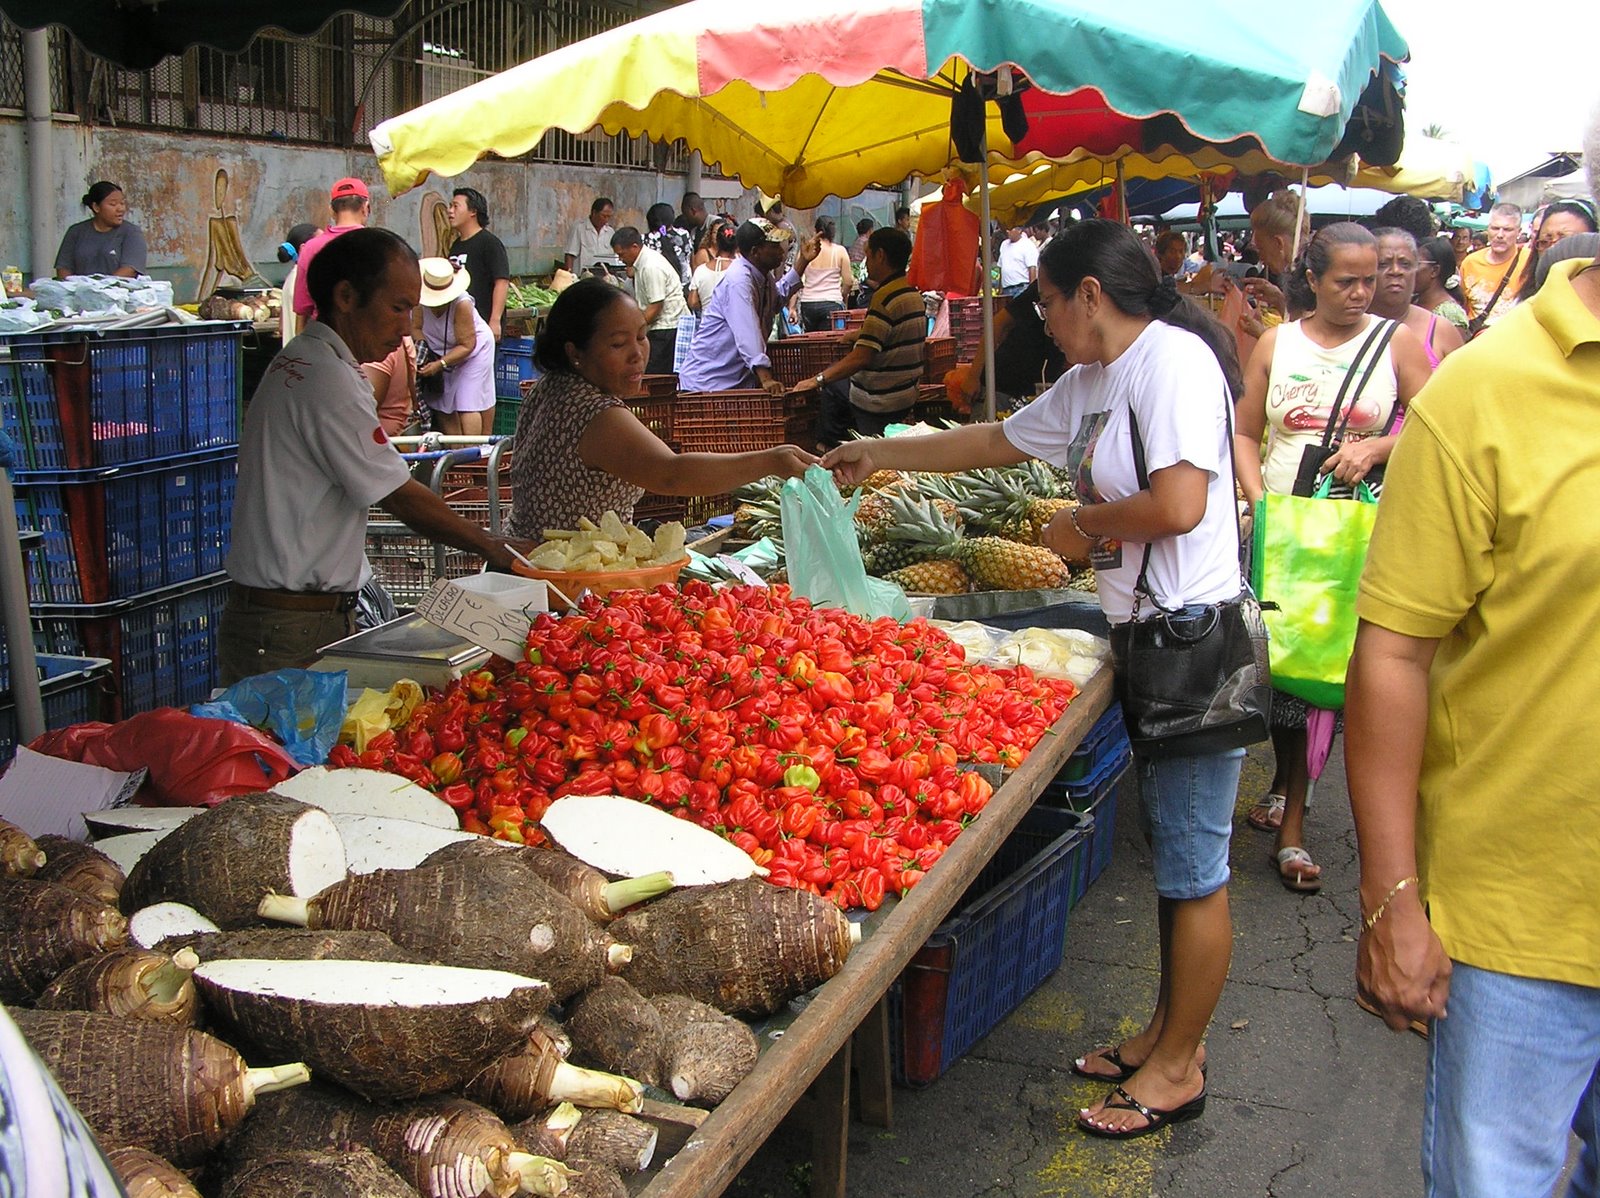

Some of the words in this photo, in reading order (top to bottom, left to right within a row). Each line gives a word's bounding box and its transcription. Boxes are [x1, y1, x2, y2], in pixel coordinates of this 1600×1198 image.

[1271, 383, 1318, 408] Cherry
[465, 597, 483, 610] €
[453, 609, 500, 642] 5
